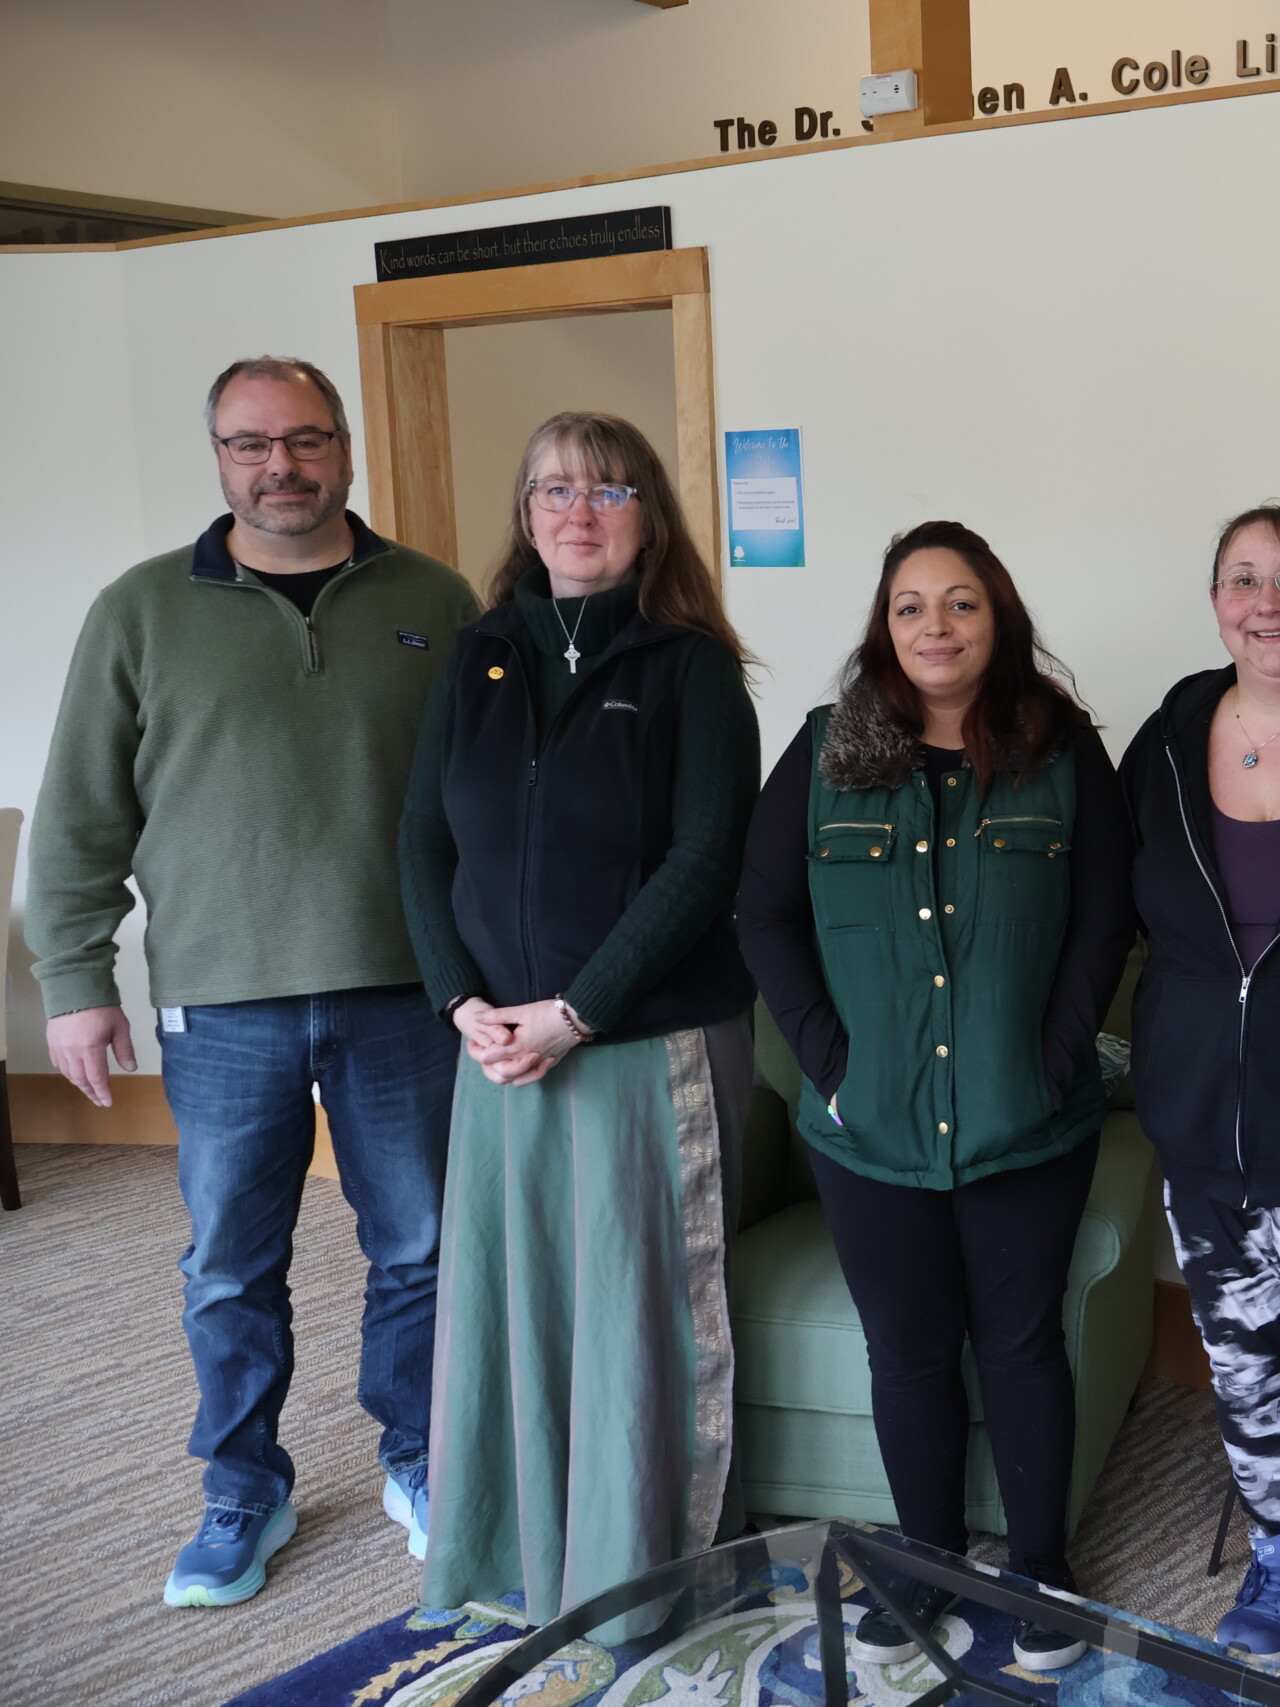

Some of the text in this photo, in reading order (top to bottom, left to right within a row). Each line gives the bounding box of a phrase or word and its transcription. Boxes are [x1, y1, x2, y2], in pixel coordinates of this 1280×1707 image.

[714, 117, 778, 152] The
[795, 107, 841, 140] Dr.
[1049, 67, 1088, 105] A.
[1112, 50, 1209, 95] Cole
[380, 246, 405, 274] Kind
[407, 243, 436, 268] words
[438, 250, 455, 265] can
[457, 240, 470, 260] be
[503, 231, 521, 255] but
[523, 229, 548, 254] their
[549, 225, 588, 250] echoes
[590, 219, 616, 253] truly
[617, 215, 660, 242] endless
